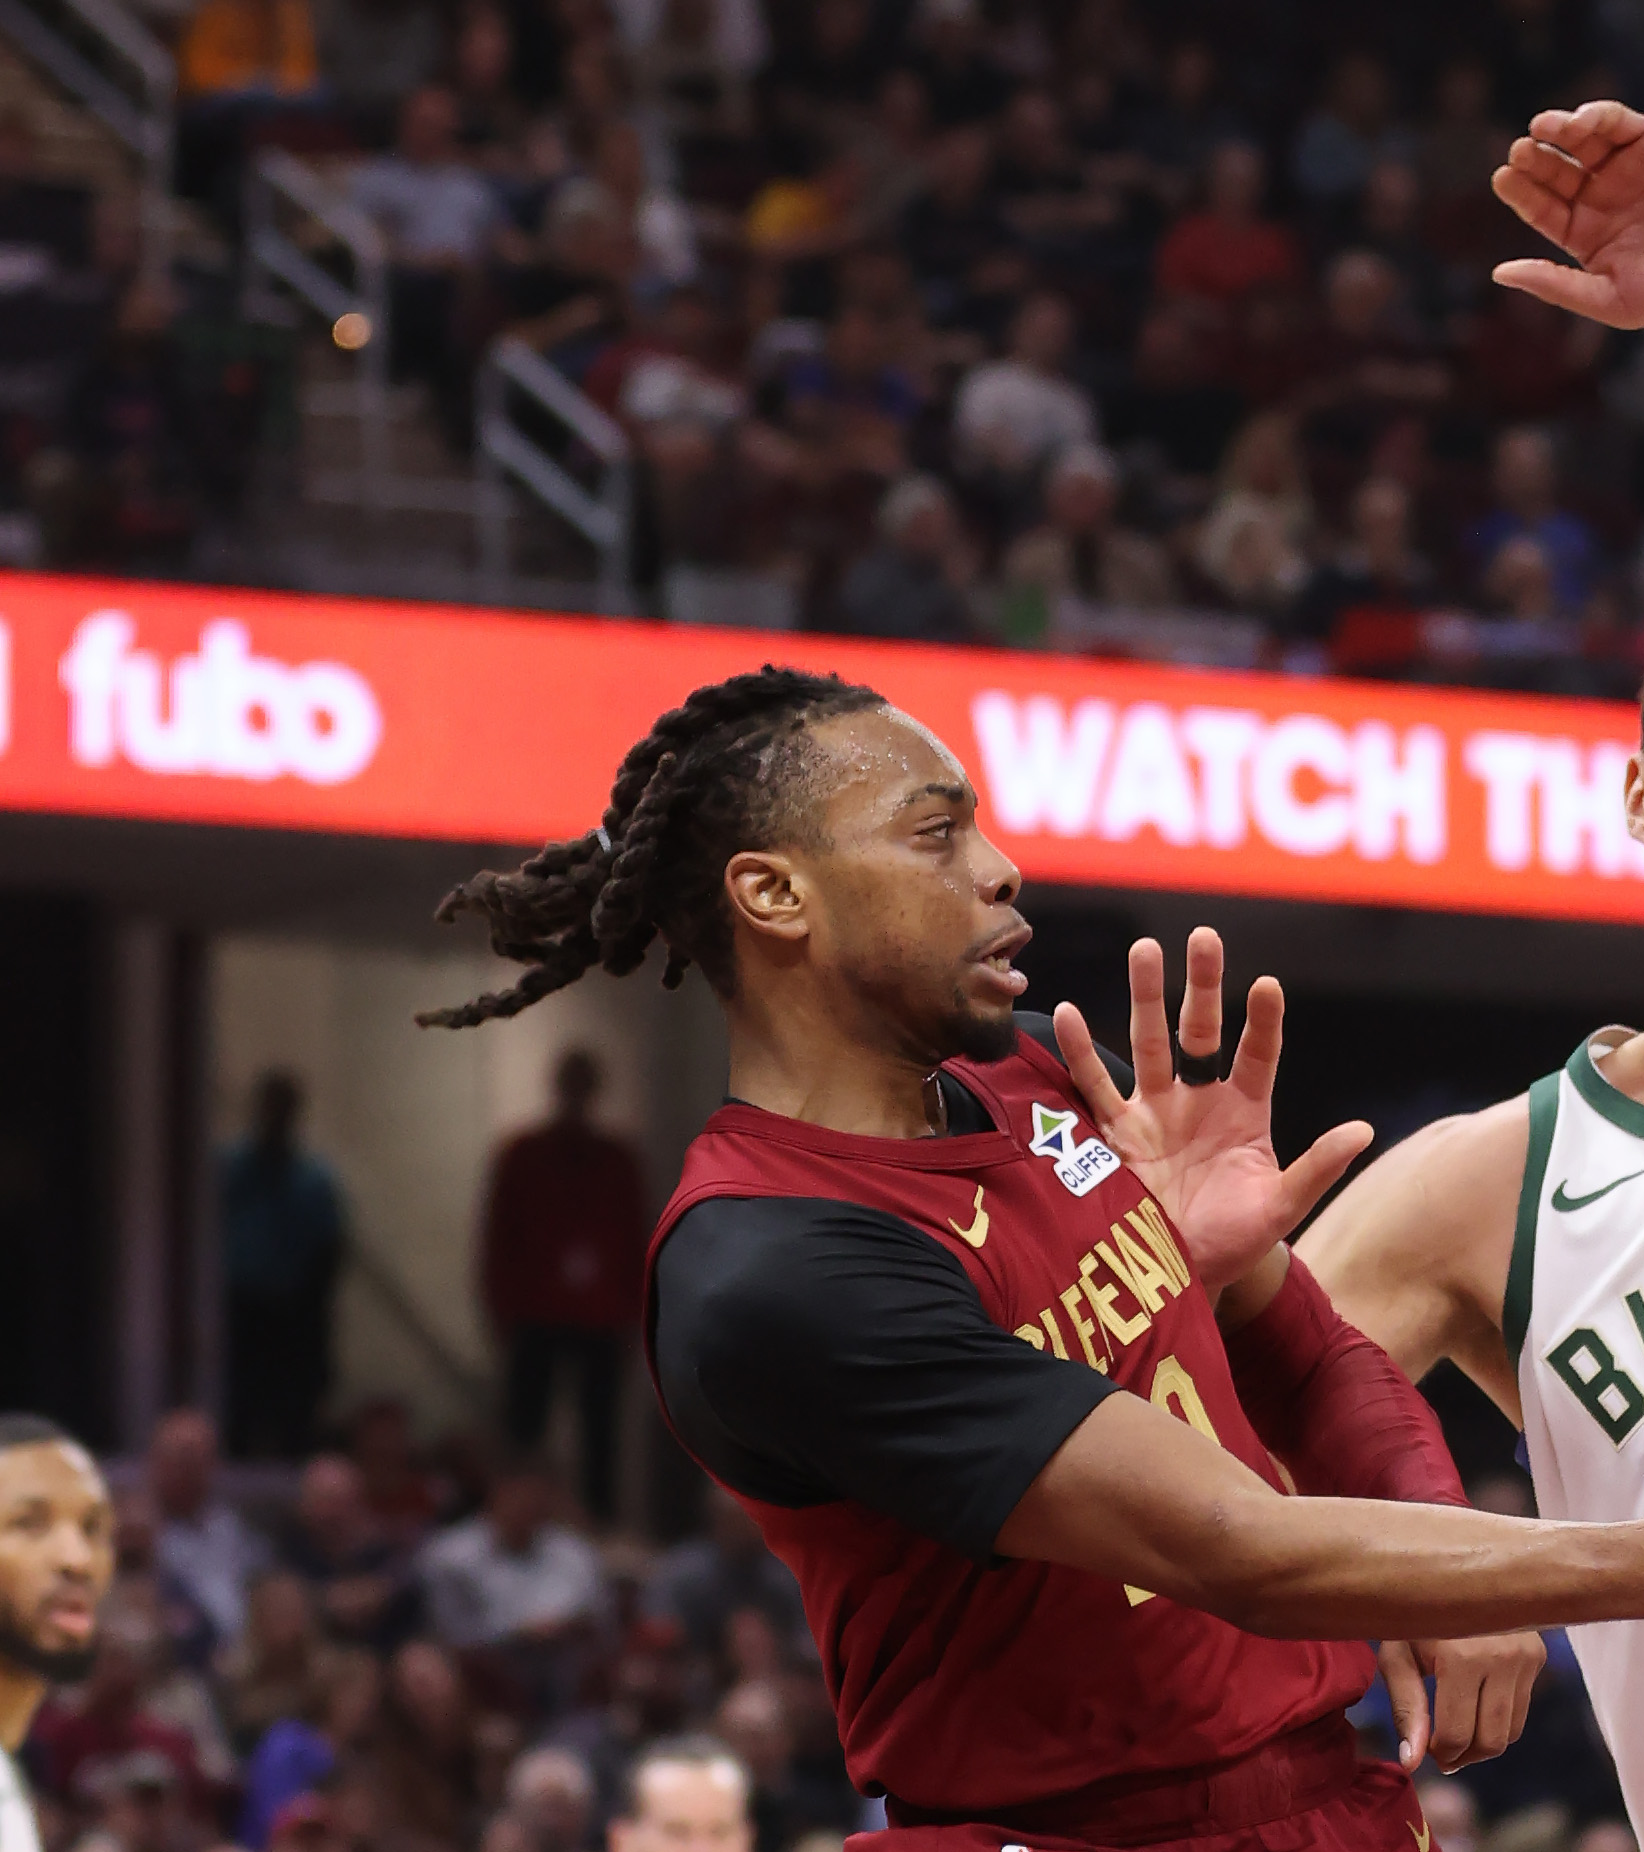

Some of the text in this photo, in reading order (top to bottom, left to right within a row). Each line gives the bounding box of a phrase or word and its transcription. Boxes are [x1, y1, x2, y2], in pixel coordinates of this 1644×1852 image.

[60, 610, 382, 787] fubo
[970, 690, 1448, 867] WATCH
[1061, 1145, 1113, 1188] CLIFFS
